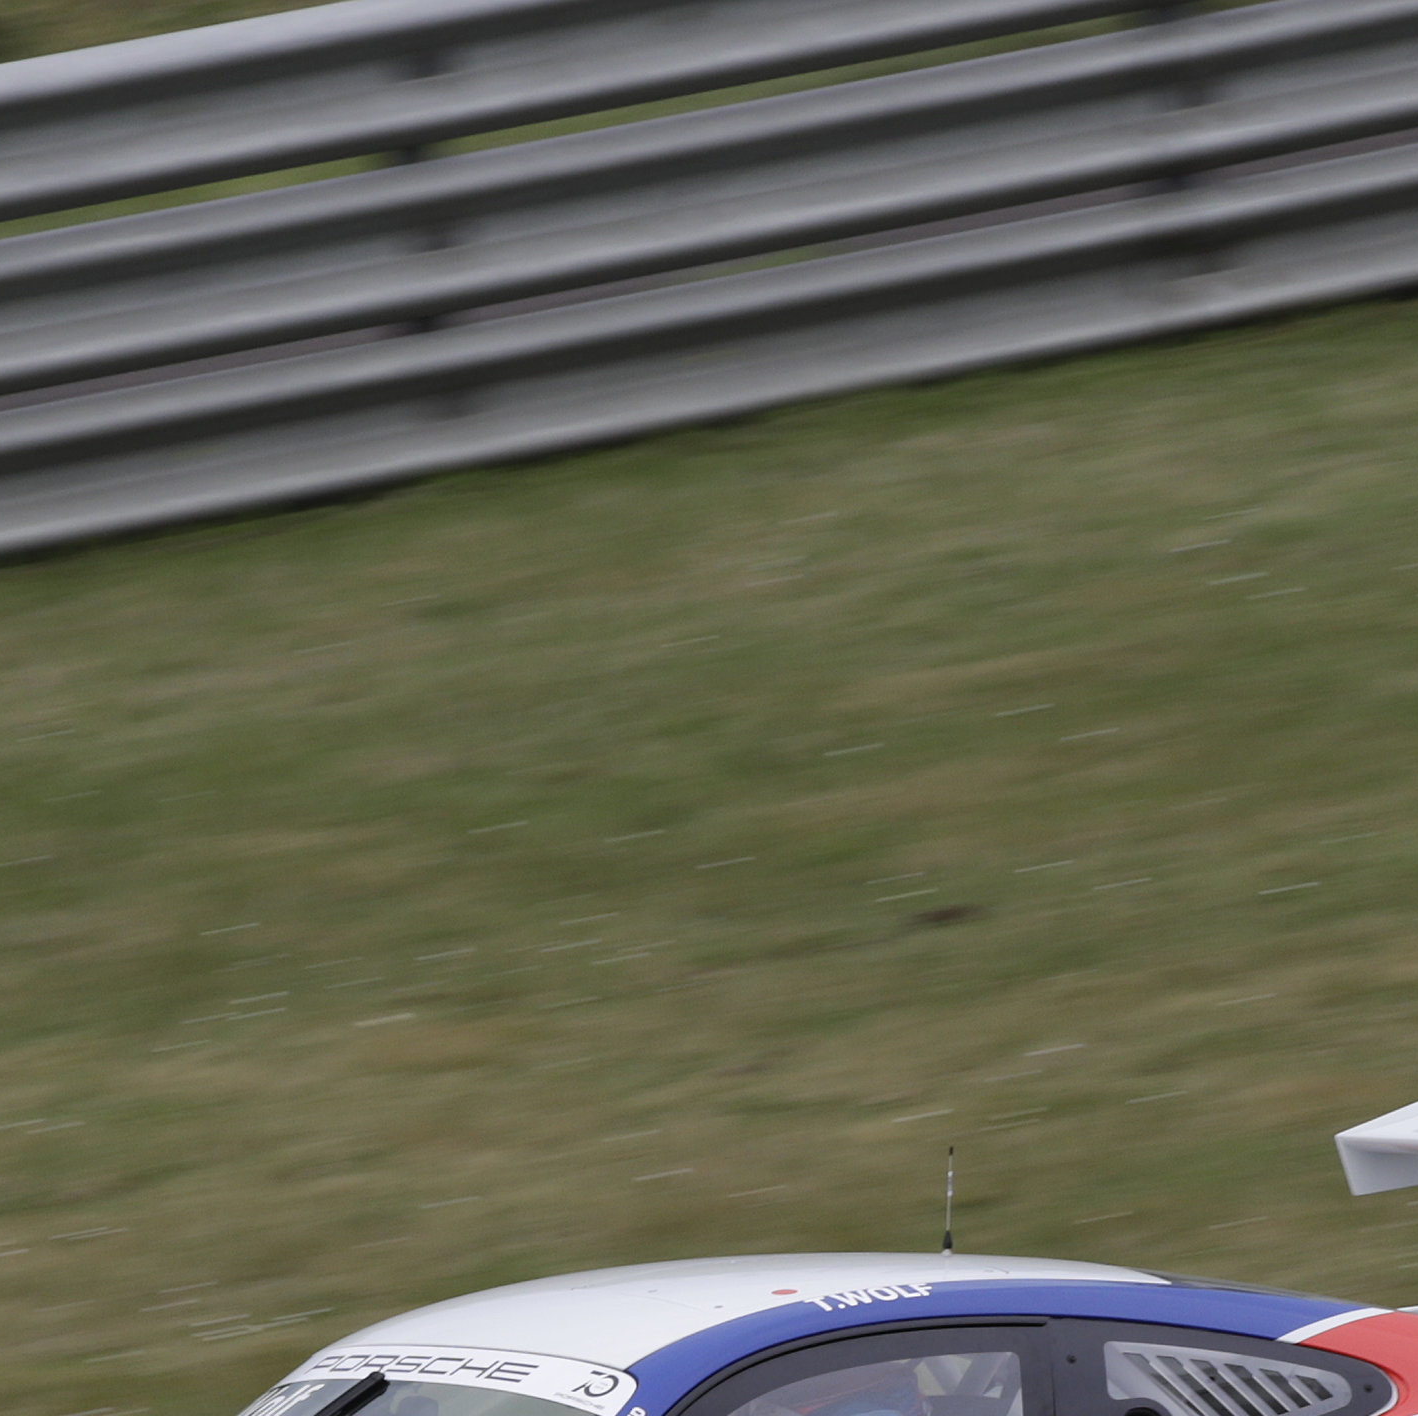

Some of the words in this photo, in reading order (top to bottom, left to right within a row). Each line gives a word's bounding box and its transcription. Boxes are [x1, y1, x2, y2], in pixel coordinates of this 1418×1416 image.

[804, 1283, 933, 1312] T.WOLF
[306, 1355, 540, 1384] PORSCHE
[571, 1370, 620, 1398] 70
